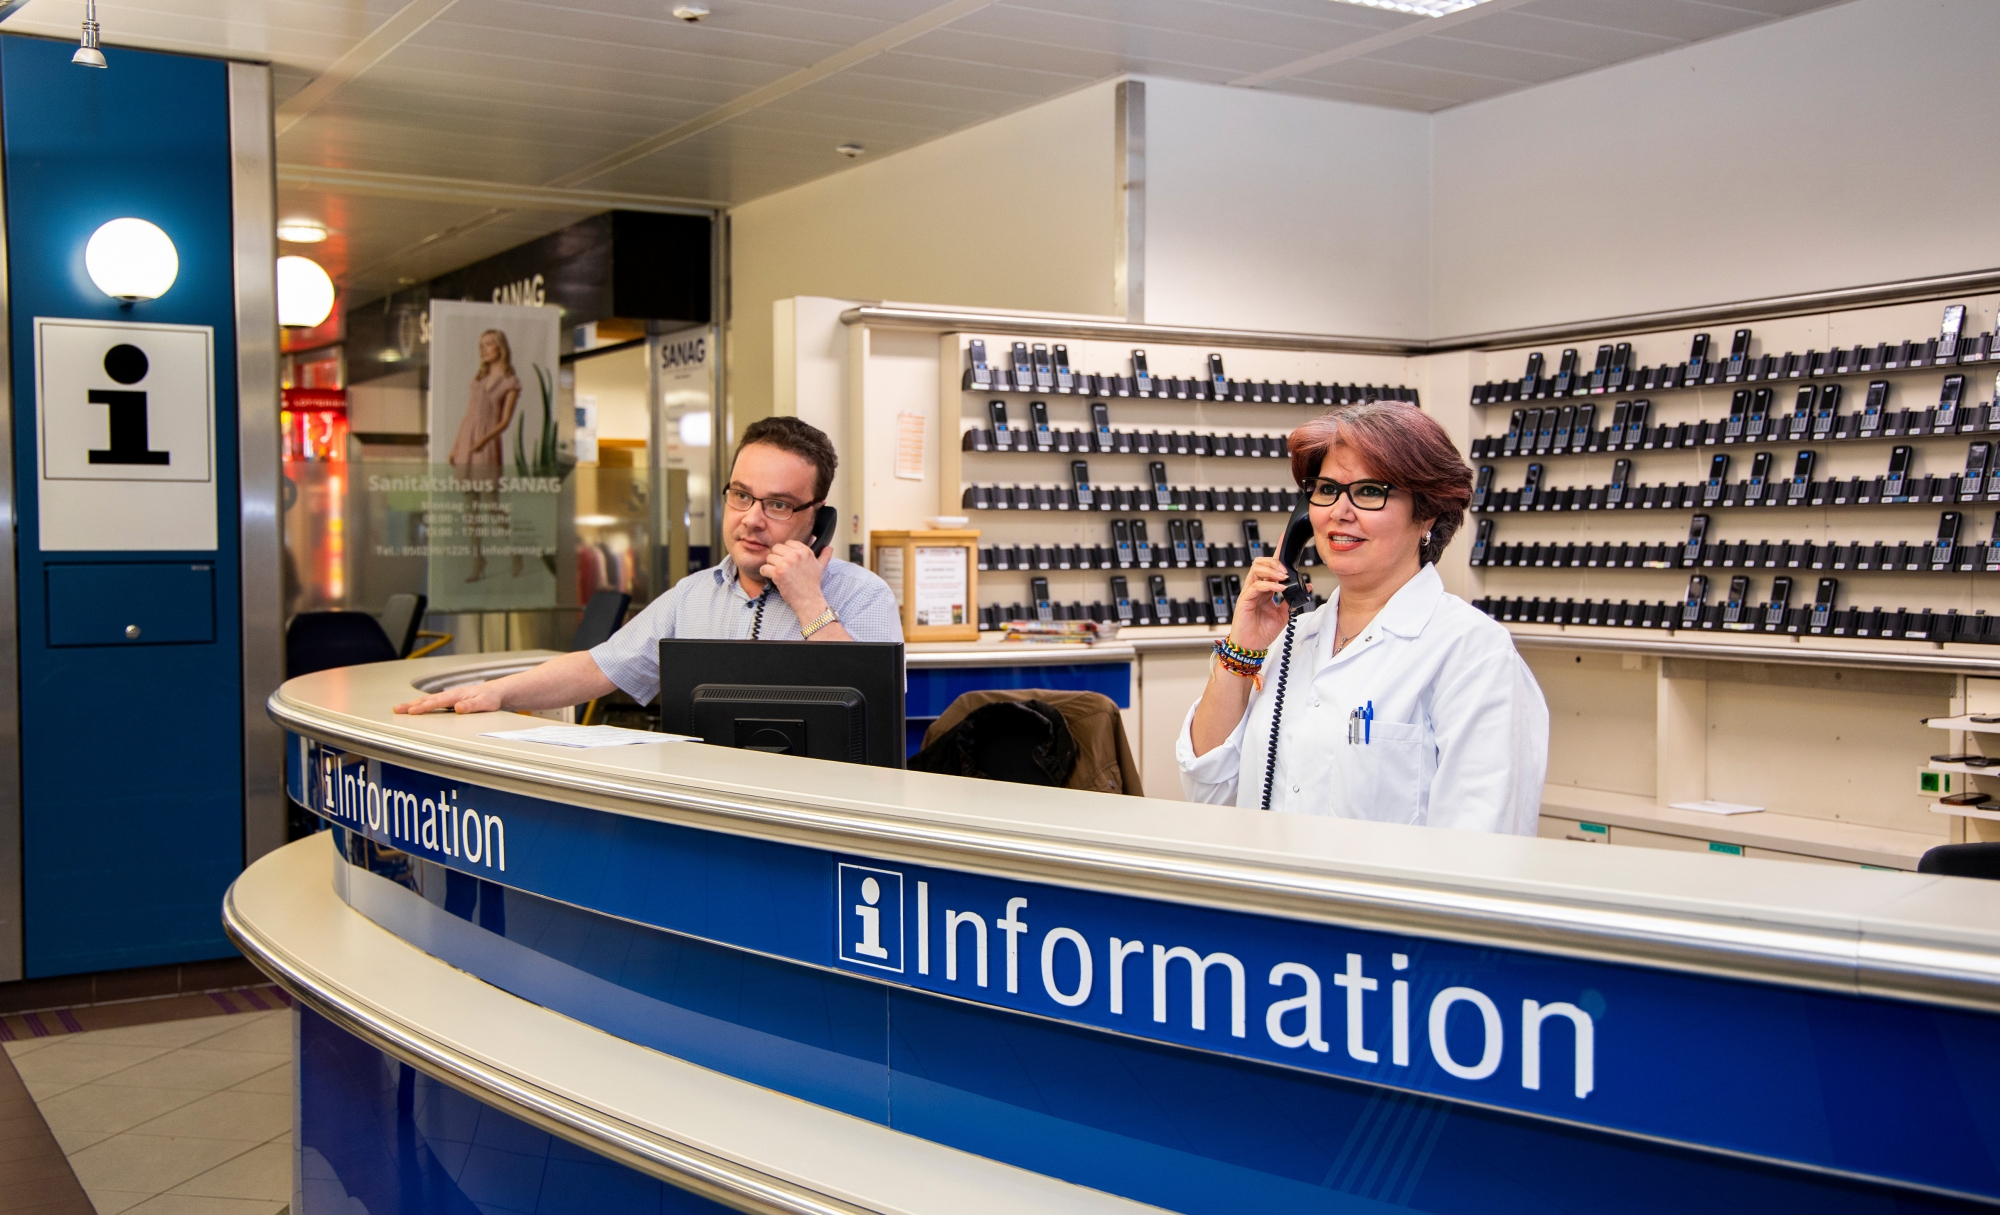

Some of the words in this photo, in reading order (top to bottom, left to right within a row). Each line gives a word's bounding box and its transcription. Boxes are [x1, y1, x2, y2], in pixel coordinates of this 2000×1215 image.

[492, 273, 546, 307] SANAG
[661, 338, 706, 369] SANAG
[367, 475, 494, 492] Sanitätshaus
[497, 476, 562, 493] SANAG
[337, 757, 505, 871] Information
[915, 880, 1596, 1100] Information
